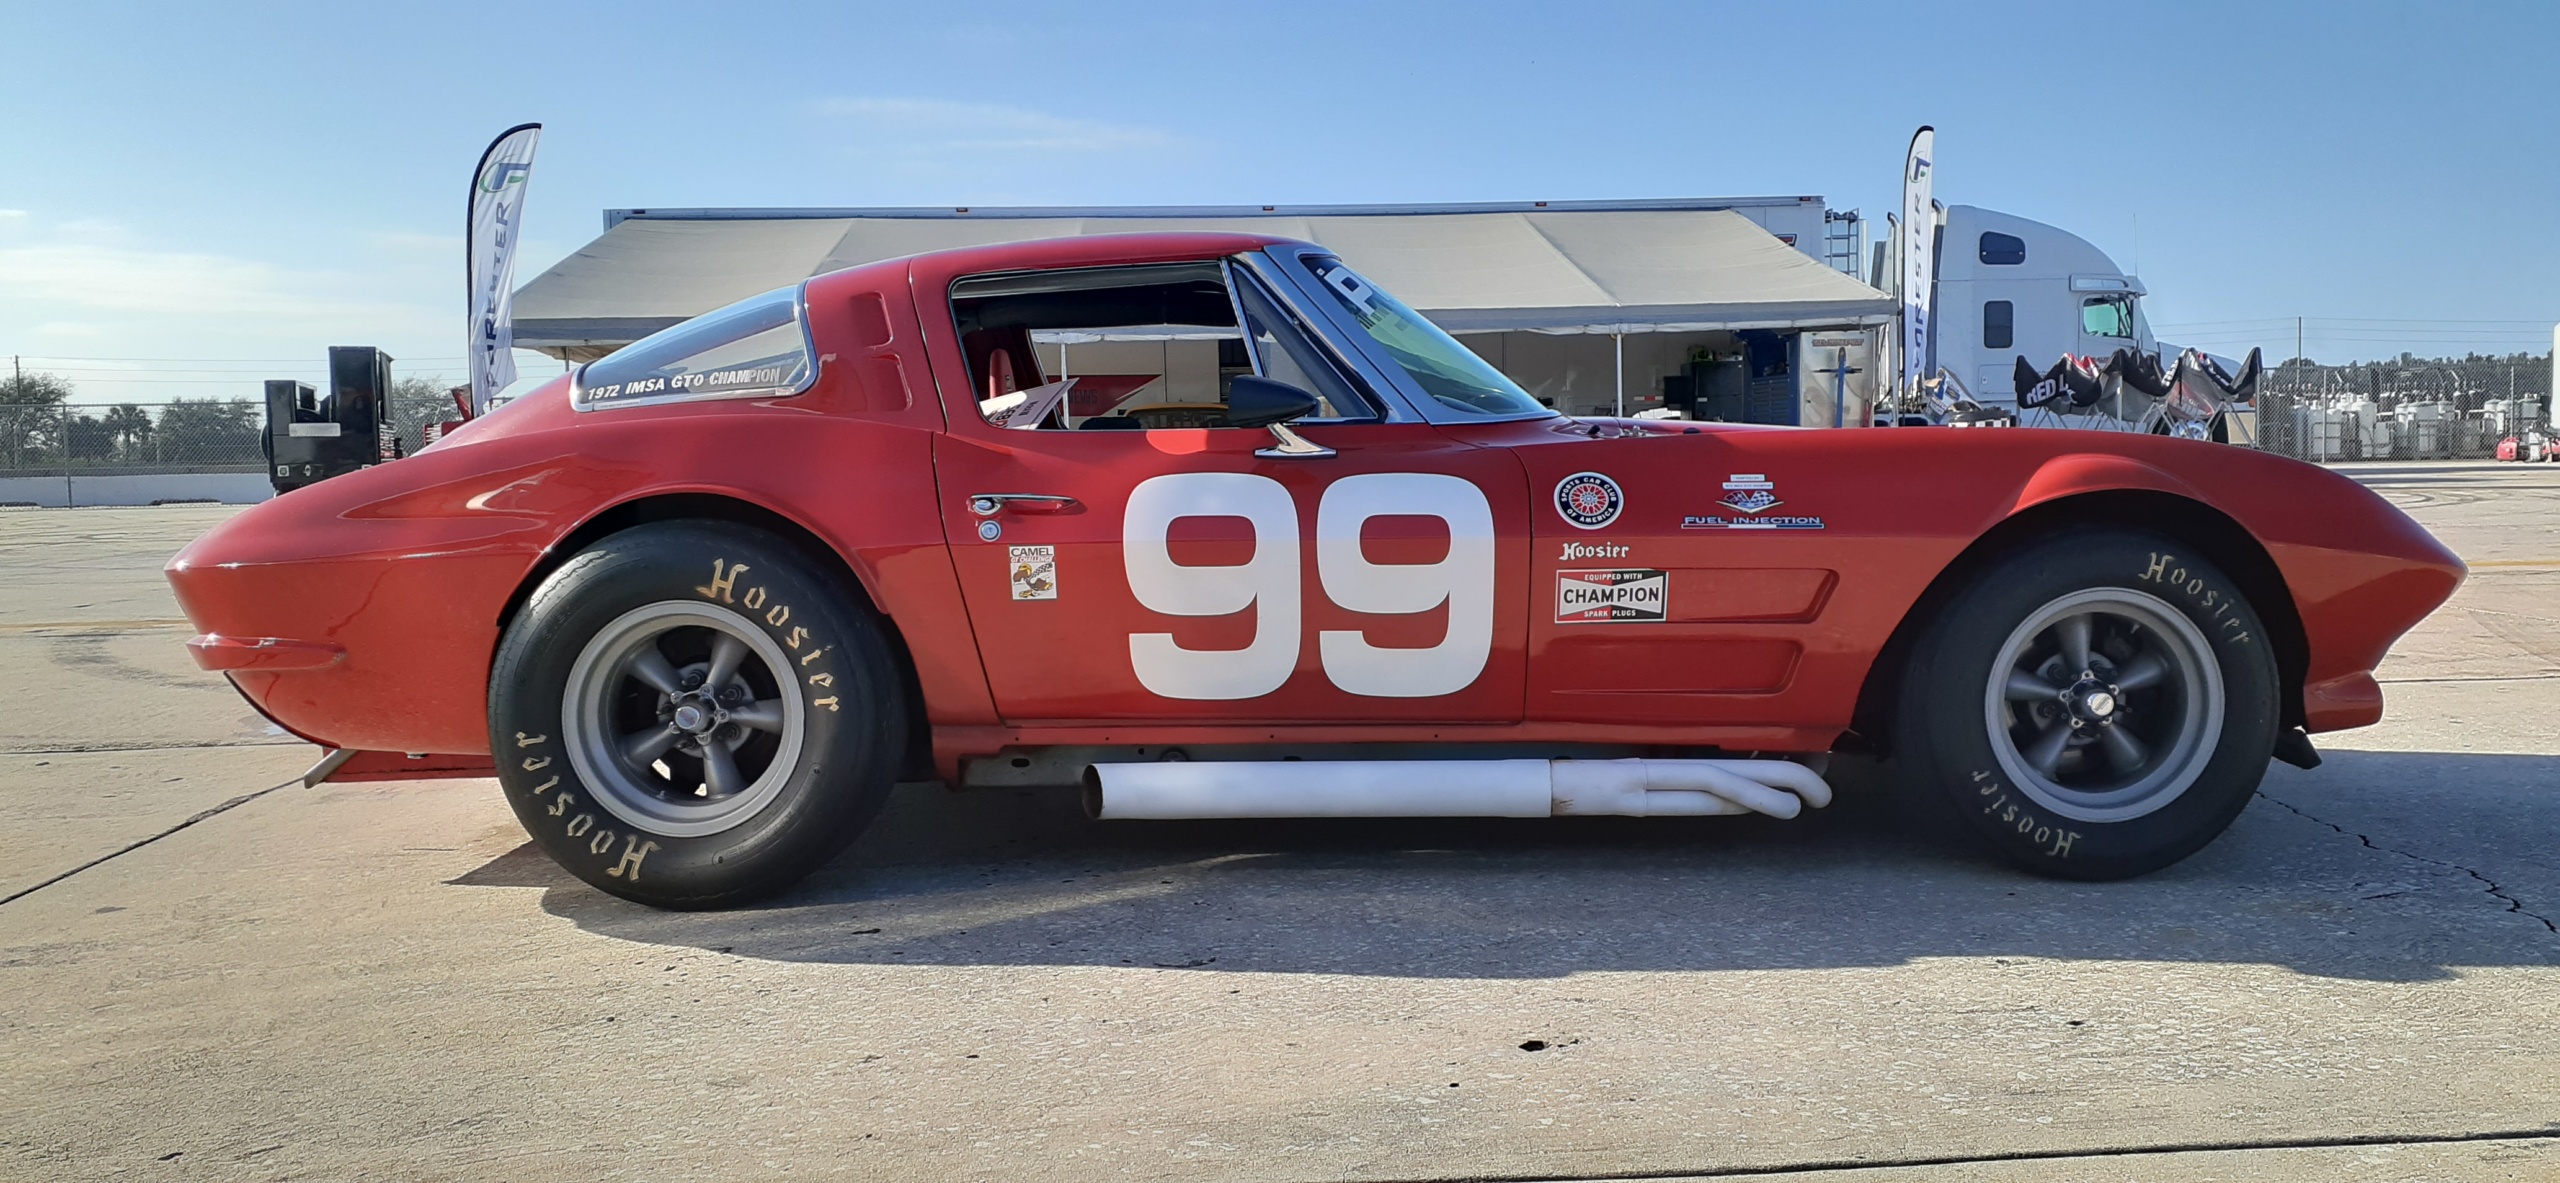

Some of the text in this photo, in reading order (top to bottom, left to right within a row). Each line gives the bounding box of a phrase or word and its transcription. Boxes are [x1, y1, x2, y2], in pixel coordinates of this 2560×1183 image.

[588, 368, 781, 400] 1972 IMSA GTO CHAMPION
[1561, 477, 1617, 502] SPORTS CAR CLUB
[1567, 507, 1614, 523] OF AMERICA
[1684, 516, 1821, 524] FUEL INJECTION
[1011, 547, 1053, 557] CAMEL
[1559, 542, 1630, 561] Hoosier
[1123, 472, 1495, 700] 99
[1584, 573, 1642, 581] EQUIPPED WITH
[1564, 587, 1660, 604] CHAMPION
[2138, 552, 2249, 644] Hoosier
[695, 558, 839, 711] Hoosier
[516, 731, 661, 882] Hoosier
[1972, 770, 2081, 858] Hoosier
